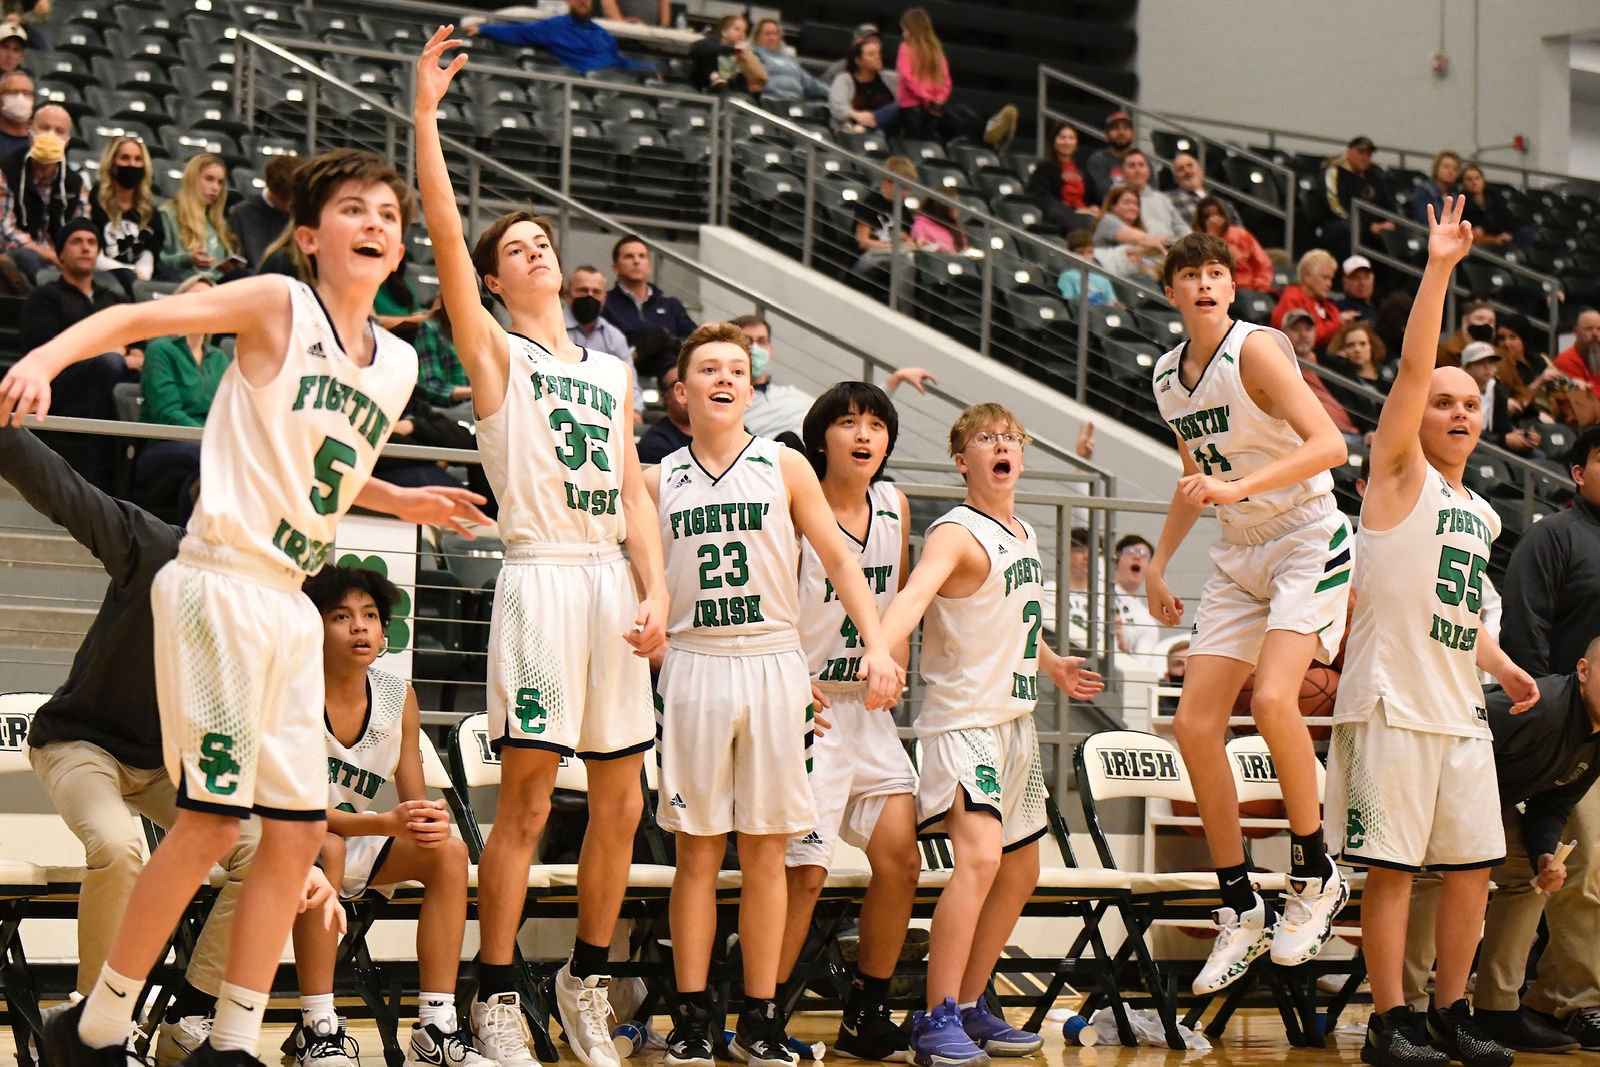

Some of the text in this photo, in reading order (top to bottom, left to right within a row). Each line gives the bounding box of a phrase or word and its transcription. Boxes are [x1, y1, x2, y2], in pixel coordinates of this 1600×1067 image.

[309, 435, 357, 516] 5
[670, 503, 770, 539] FIGHTIN'
[697, 541, 749, 590] 23
[1435, 545, 1488, 614] 55
[693, 595, 765, 628] IRISH
[840, 614, 865, 648] 4
[1023, 600, 1042, 659] 2
[1098, 750, 1178, 779] IRISH
